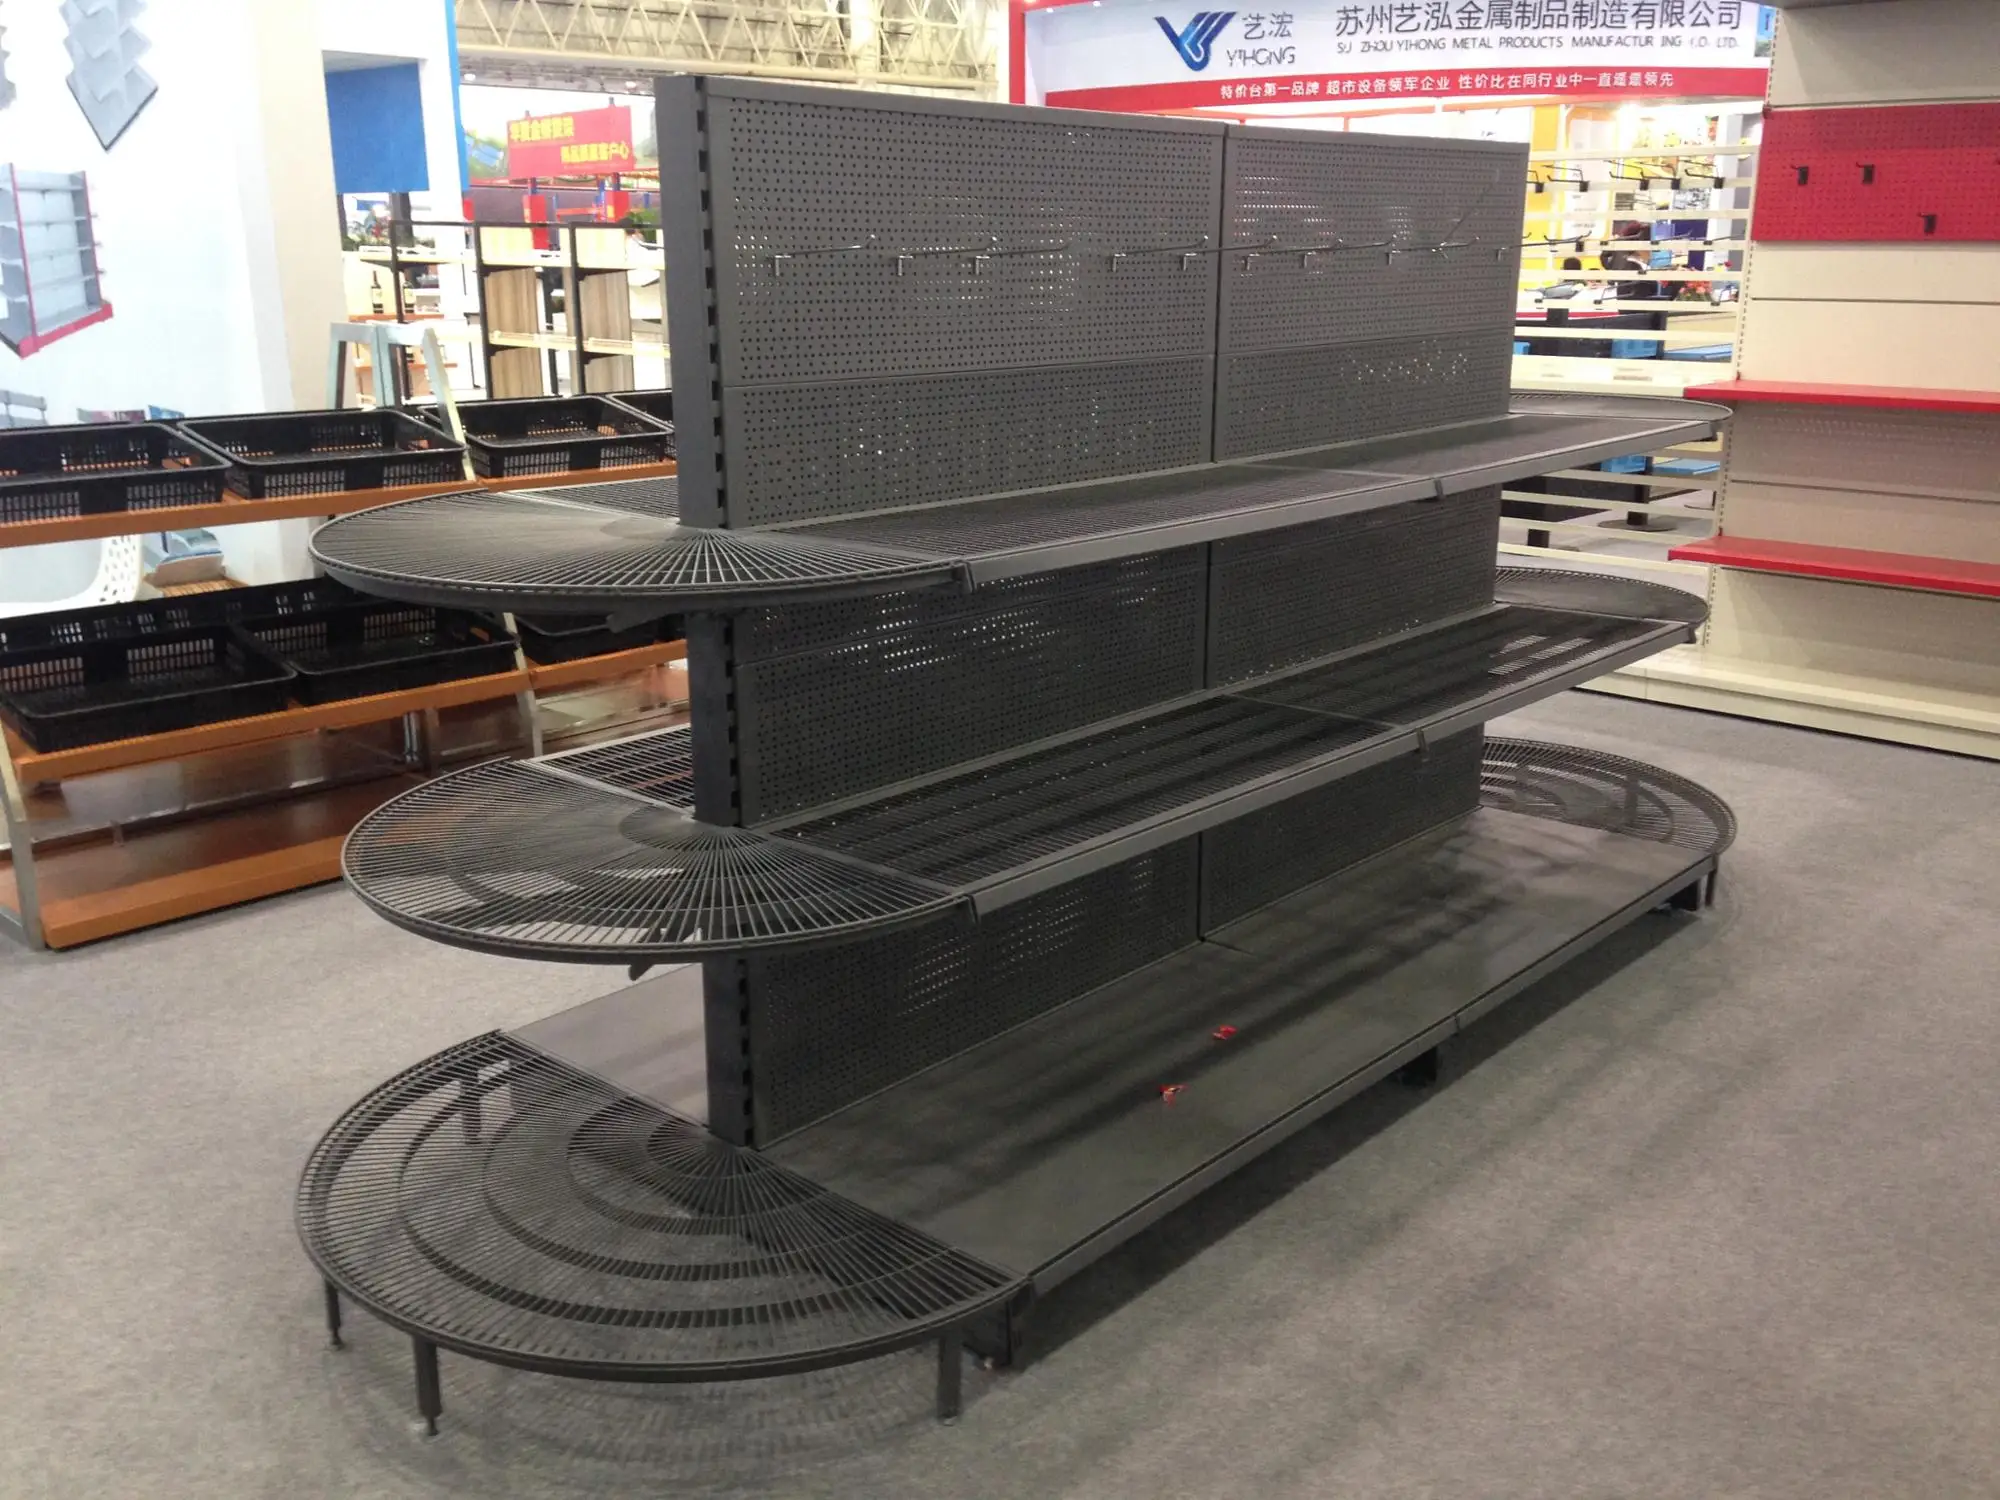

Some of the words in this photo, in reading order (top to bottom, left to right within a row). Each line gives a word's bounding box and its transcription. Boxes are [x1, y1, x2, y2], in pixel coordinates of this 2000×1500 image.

[1336, 0, 1741, 36] 苏州艺泓金属制品制造有限公司
[1396, 37, 1446, 51] YIHONG
[1452, 37, 1492, 49] METAL
[1499, 36, 1563, 49] PRODUCTS
[1226, 46, 1295, 67] YIHONG
[1219, 80, 1320, 100] 特价台第一品牌
[1326, 76, 1450, 95] 超市设备领军企业
